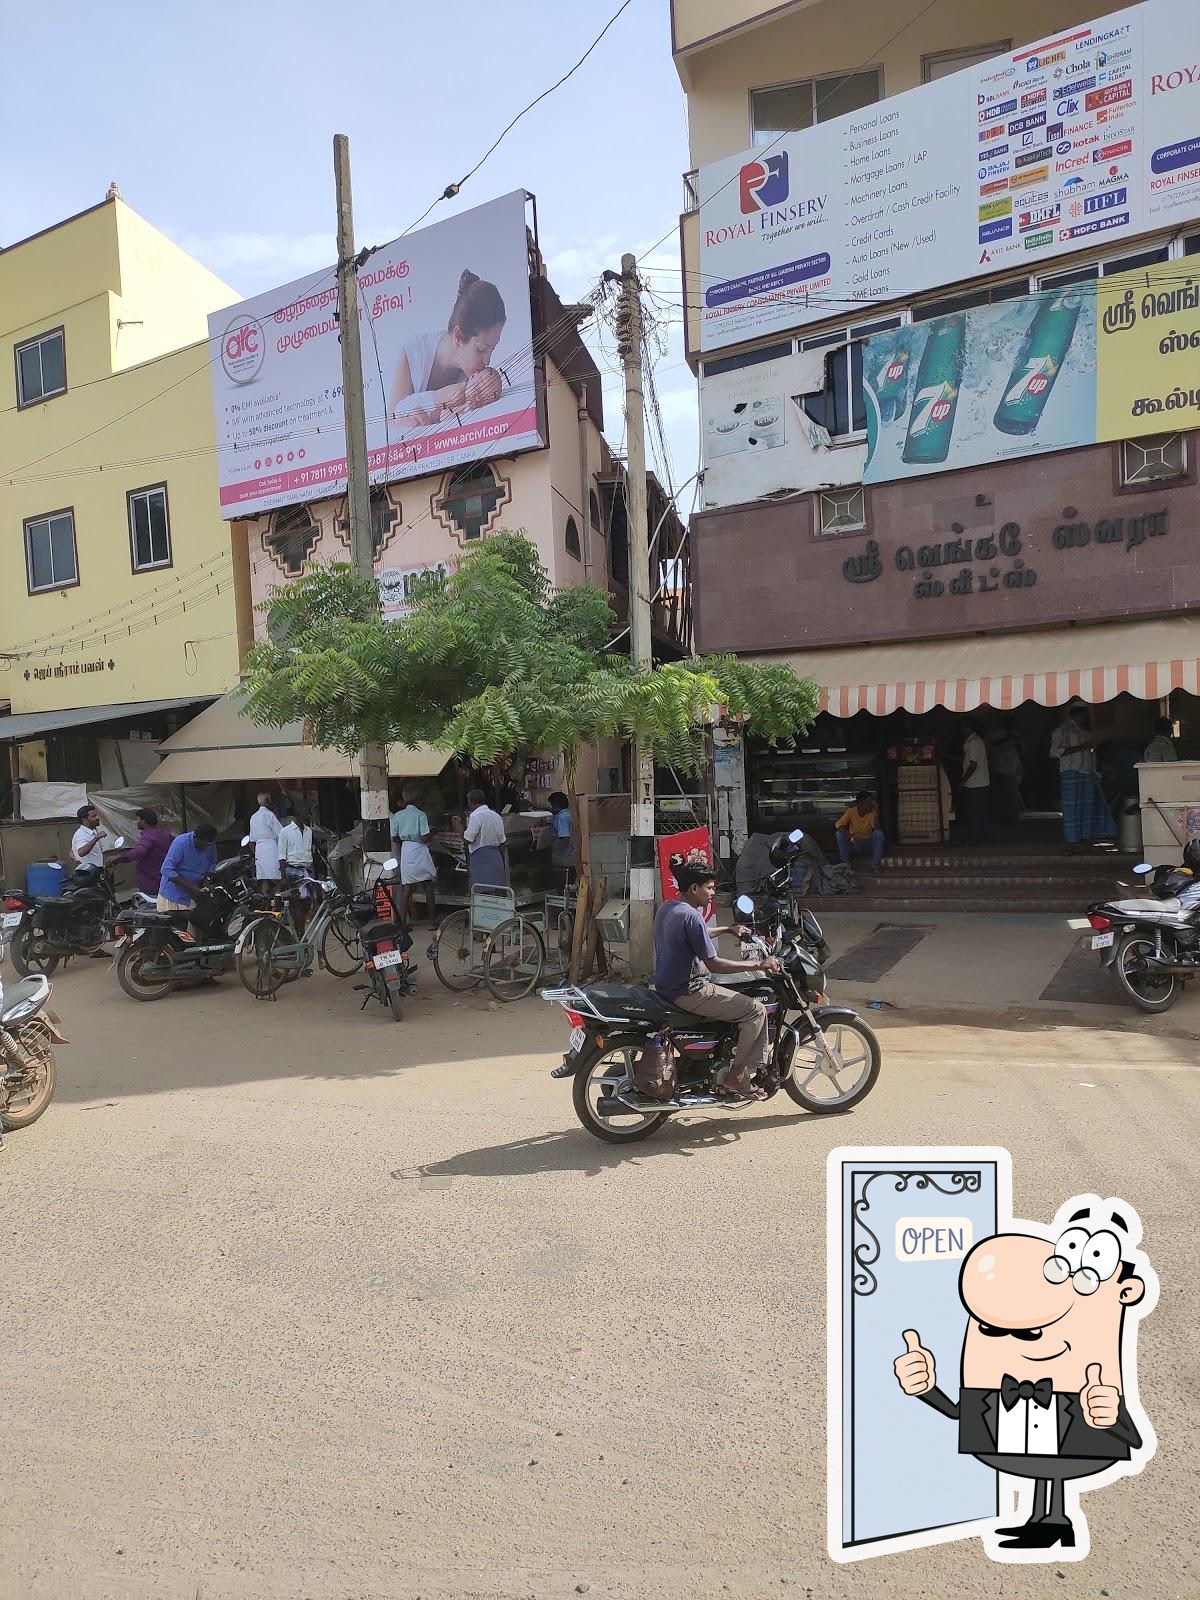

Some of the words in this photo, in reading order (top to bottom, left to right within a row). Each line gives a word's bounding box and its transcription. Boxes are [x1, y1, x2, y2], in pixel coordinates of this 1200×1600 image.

[1065, 59, 1092, 75] Chola
[1108, 64, 1132, 77] CAPITAL
[1151, 63, 1200, 96] ROYA
[1103, 88, 1131, 103] CAPITAL
[986, 106, 1001, 118] HDB
[1056, 98, 1080, 117] Clix
[849, 114, 878, 135] Personal
[880, 111, 900, 125] Loans
[1009, 121, 1024, 133] DCB
[1025, 114, 1045, 127] BANK
[1063, 121, 1094, 137] FINANCE
[849, 138, 878, 152] Business
[879, 128, 899, 142] Loans
[1073, 134, 1100, 149] kotak
[850, 155, 870, 168] Home
[871, 147, 891, 161] Loans
[850, 168, 884, 185] Mortgage
[885, 161, 905, 174] Loans
[913, 150, 928, 164] LAP
[1055, 152, 1089, 172] InCred
[1053, 181, 1096, 199] shubham
[1098, 173, 1129, 187] MAGMA
[1150, 176, 1175, 190] ROYAL
[850, 189, 887, 206] Machinery
[888, 181, 909, 194] Loans
[1085, 190, 1125, 213] IIFL
[850, 205, 884, 226] Overdraft
[891, 199, 910, 214] Cash
[911, 191, 935, 208] Credit
[935, 183, 961, 200] Facility
[705, 219, 755, 248] ROYAL
[760, 194, 828, 230] FINSERV
[1073, 224, 1098, 236] HDFC
[1100, 216, 1126, 229] BANK
[761, 225, 794, 244] Together
[851, 232, 872, 247] Credit
[873, 225, 894, 241] Cards
[852, 254, 868, 265] Auto
[869, 246, 889, 260] Loans
[852, 269, 869, 285] Gold
[870, 267, 890, 280] Loans
[786, 284, 808, 298] PRIVATE
[809, 277, 832, 291] LIMITED
[869, 285, 889, 297] Loans
[255, 407, 283, 421] advanced
[284, 398, 317, 413] technology
[263, 418, 288, 433] discount
[298, 408, 327, 420] treatment
[434, 421, 510, 451] www.arcivf.com
[300, 473, 310, 483] 91
[310, 469, 327, 481] 7811
[327, 463, 343, 476] 999
